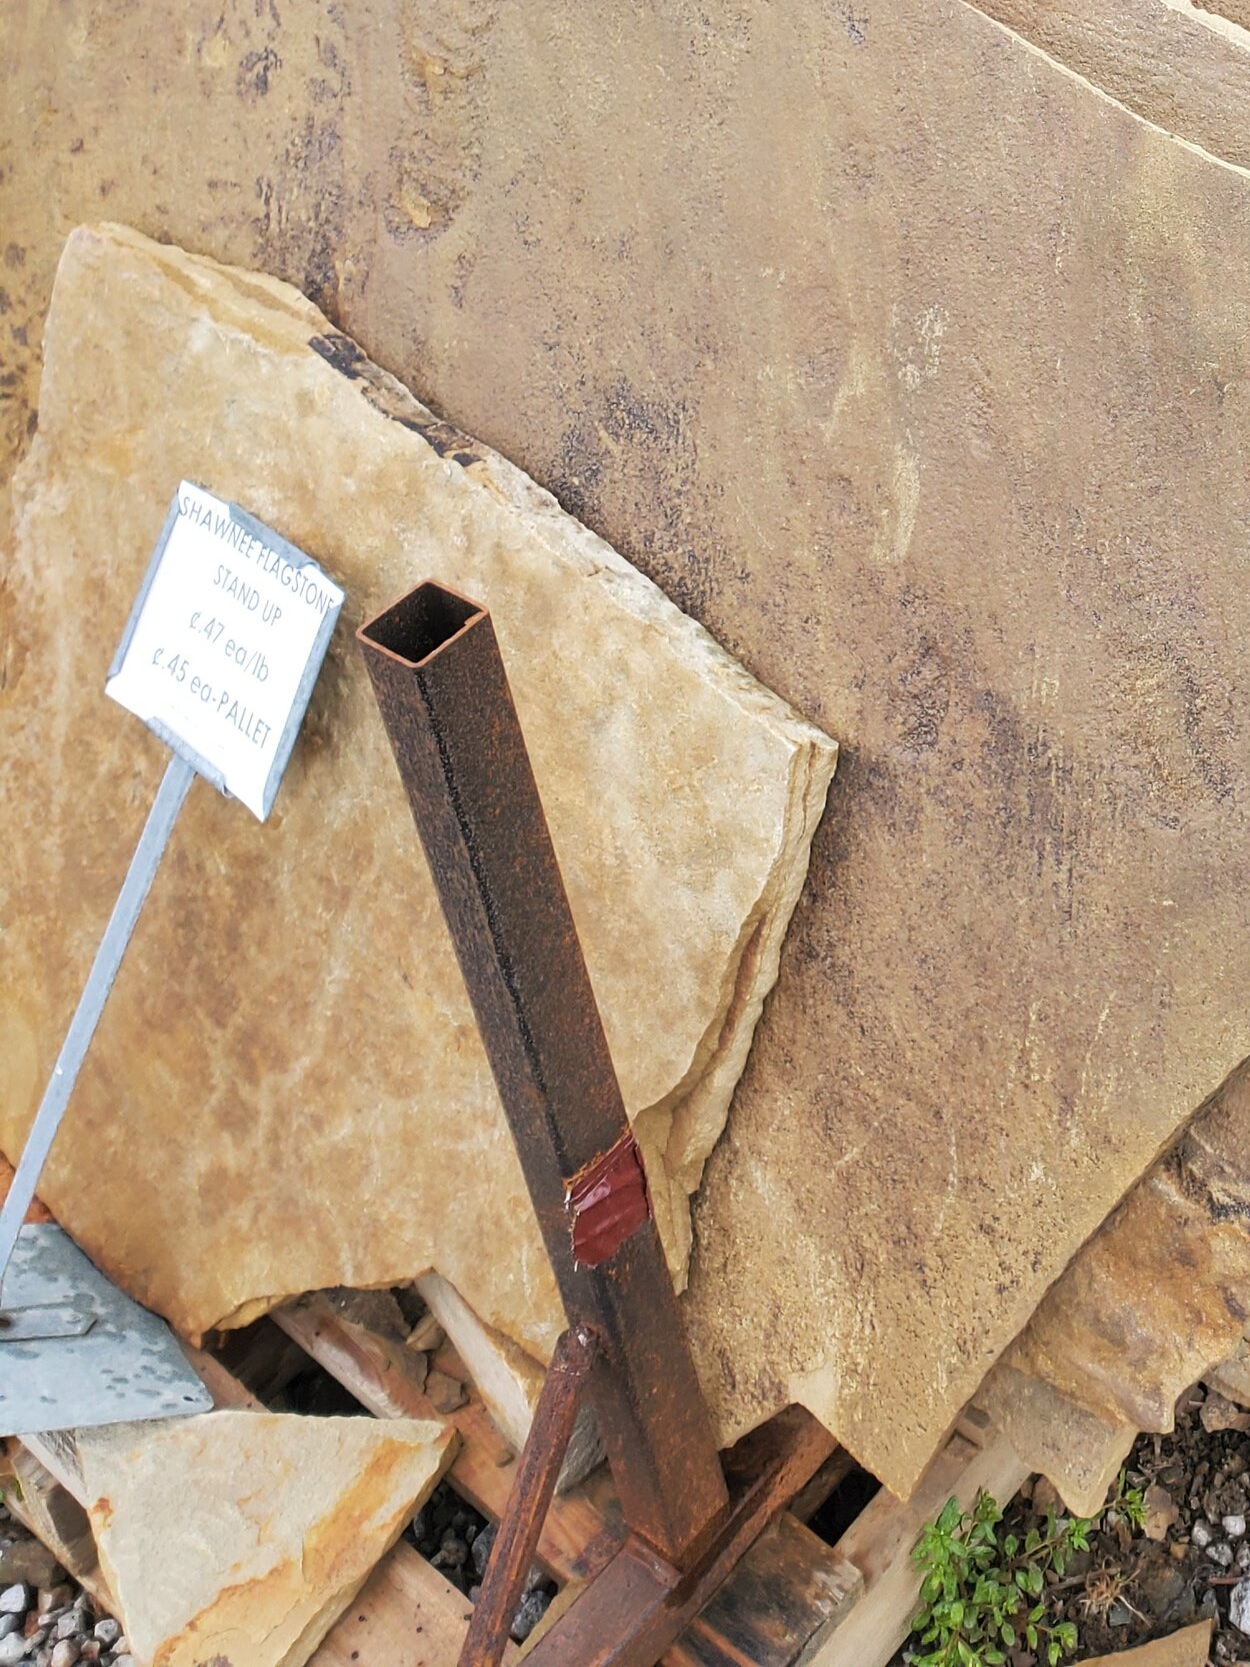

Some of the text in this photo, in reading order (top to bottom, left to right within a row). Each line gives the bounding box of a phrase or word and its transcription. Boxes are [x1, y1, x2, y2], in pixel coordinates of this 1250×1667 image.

[179, 495, 255, 559] SHAWNEE
[213, 564, 282, 627] STAND UP
[225, 638, 269, 682] ea/lb
